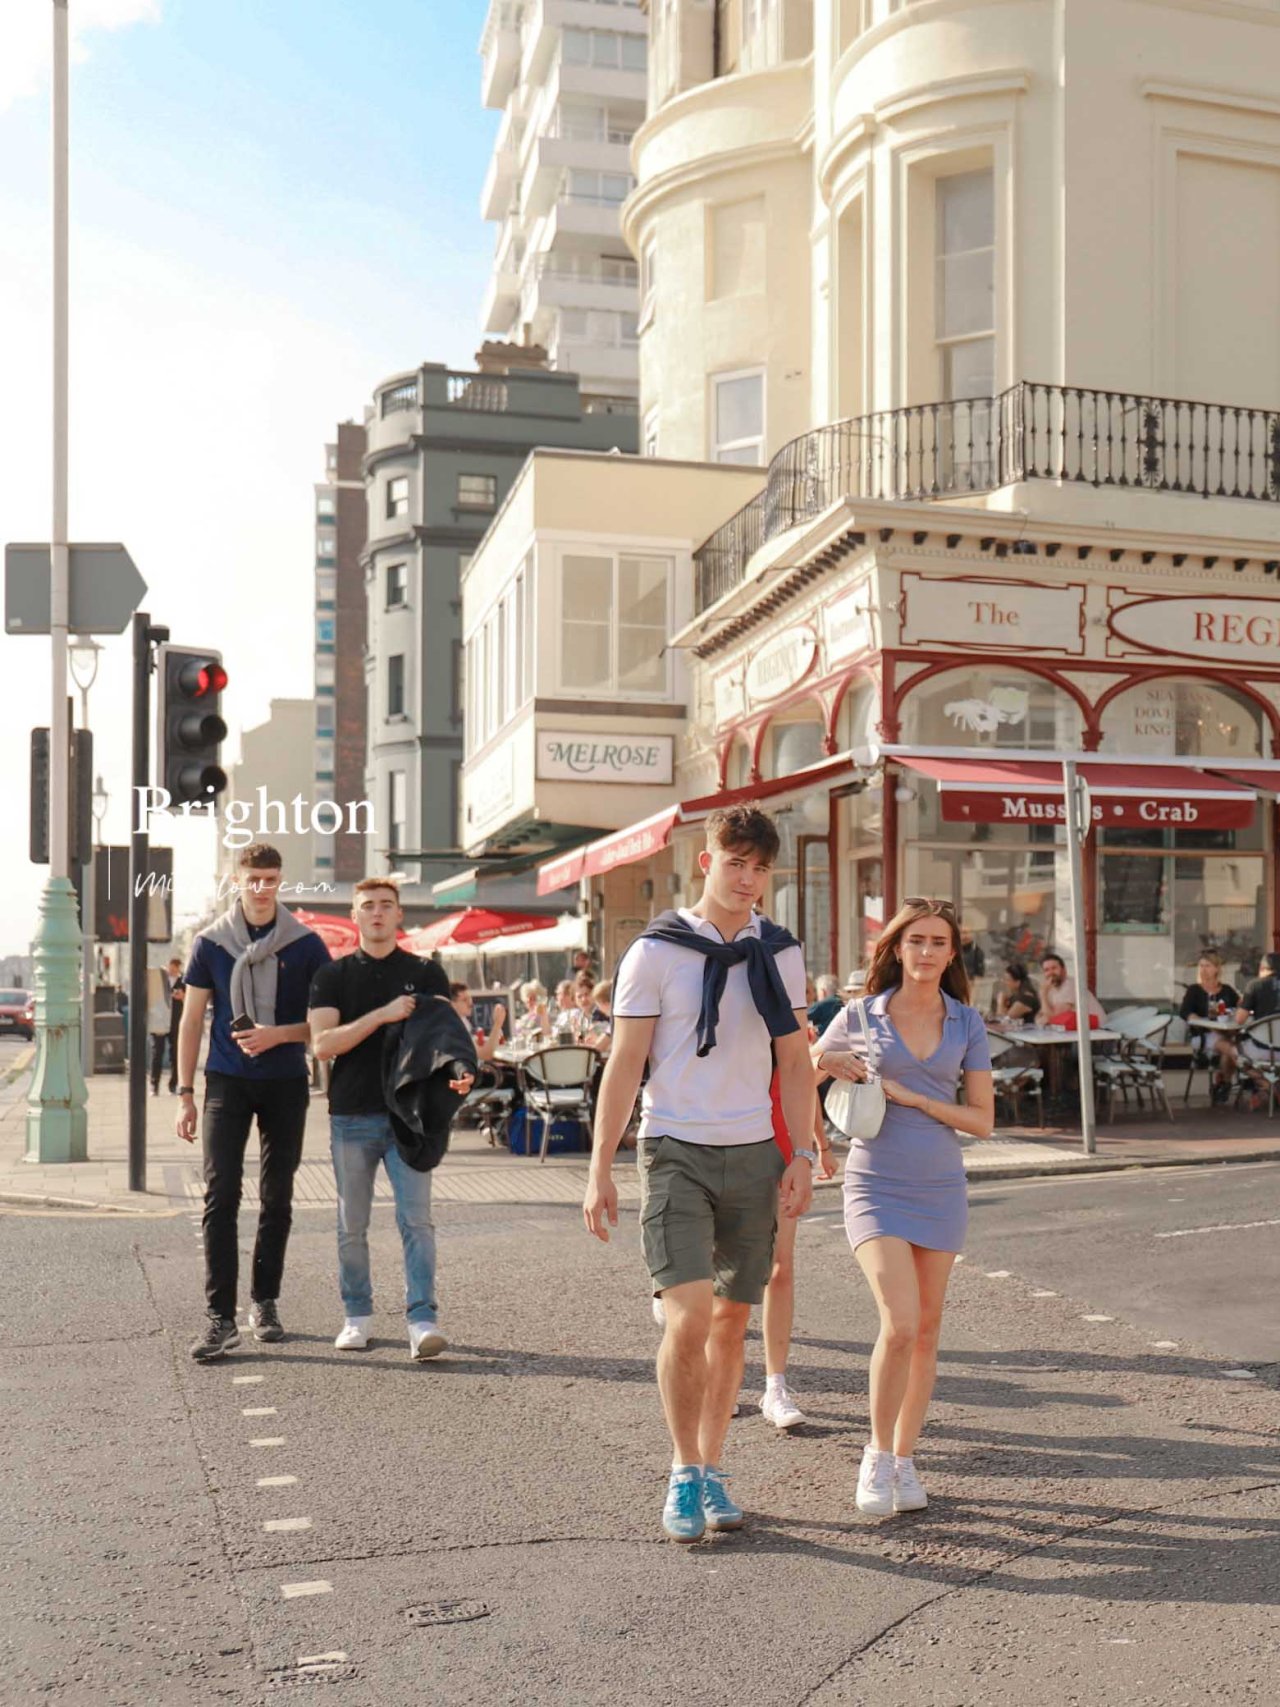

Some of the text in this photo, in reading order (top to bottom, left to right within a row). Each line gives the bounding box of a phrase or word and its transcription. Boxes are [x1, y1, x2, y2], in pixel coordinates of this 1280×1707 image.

[967, 602, 1020, 626] The
[1135, 723, 1172, 737] KING
[547, 742, 661, 774] MELROSE
[1002, 797, 1199, 823] Musss Crab
